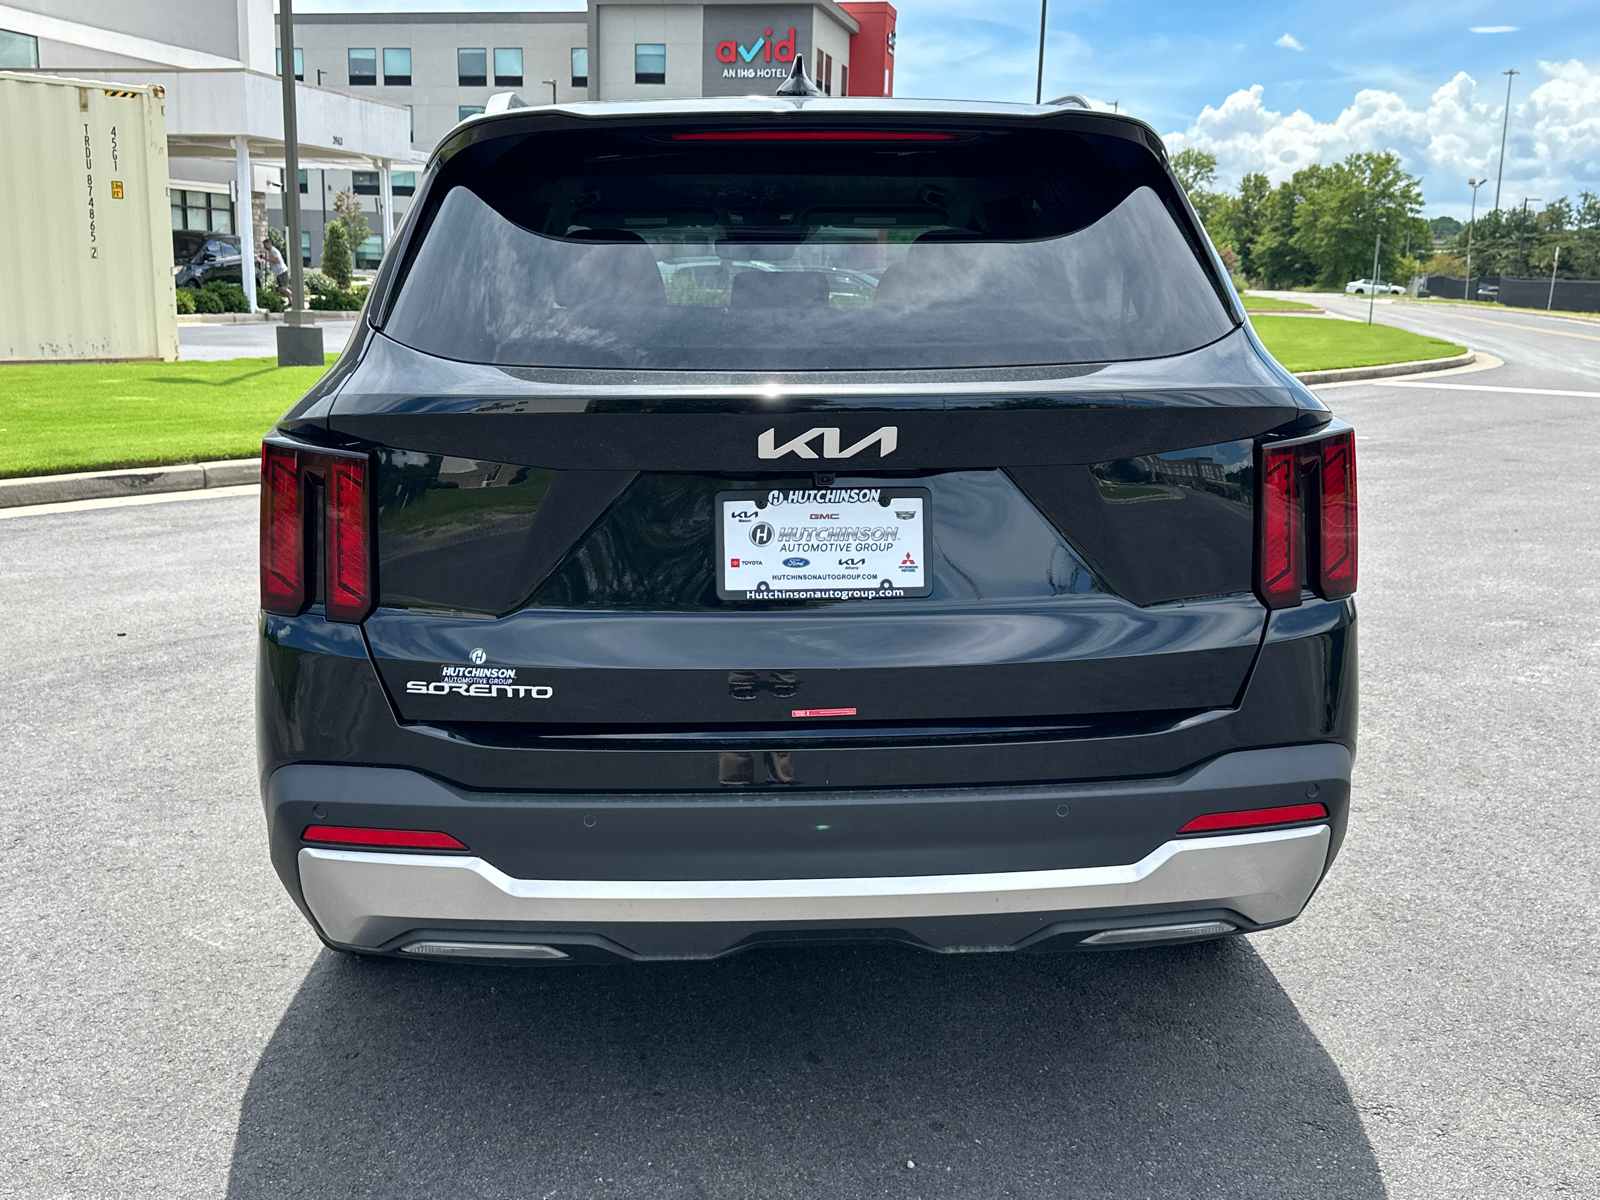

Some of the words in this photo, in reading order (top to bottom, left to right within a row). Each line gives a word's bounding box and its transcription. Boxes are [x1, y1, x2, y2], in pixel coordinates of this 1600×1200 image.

[716, 27, 796, 63] avid
[722, 68, 736, 78] AN
[737, 68, 756, 78] IHG
[757, 68, 788, 78] HOTEL
[84, 124, 92, 170] TRDU
[86, 174, 96, 243] 874865
[758, 426, 898, 459] KIA
[787, 489, 881, 504] HUTCHINSON
[731, 510, 759, 520] KIA
[777, 526, 900, 542] HUTCHINSON
[780, 543, 853, 552] AUTOMOTIVE
[855, 542, 894, 552] GROUP
[787, 558, 807, 568] Ford
[838, 558, 866, 566] KIA
[746, 588, 904, 600] Hutchinsonautogroup.com
[442, 666, 516, 678] HUTCHINSON
[444, 676, 487, 684] AUTOMOTIVE
[406, 680, 553, 699] SORENTO
